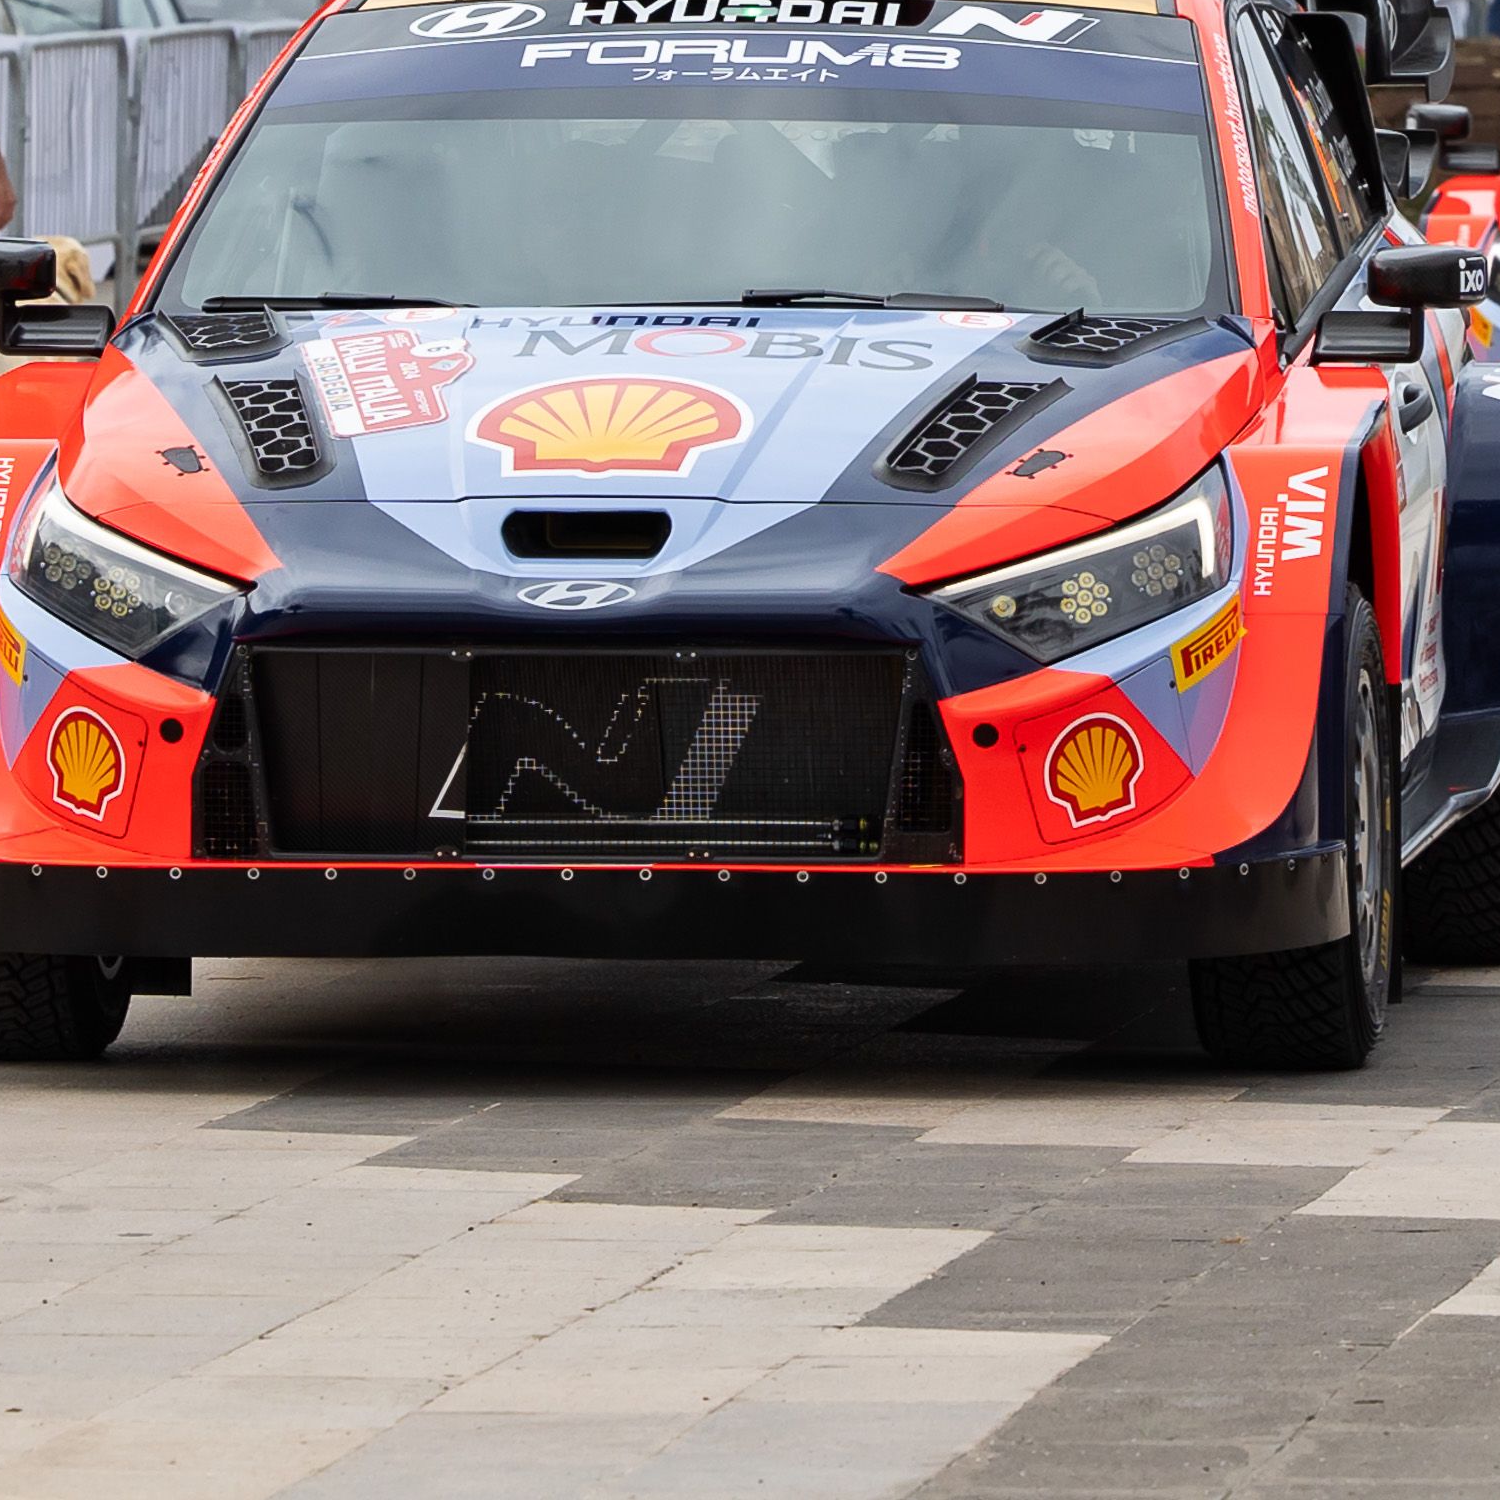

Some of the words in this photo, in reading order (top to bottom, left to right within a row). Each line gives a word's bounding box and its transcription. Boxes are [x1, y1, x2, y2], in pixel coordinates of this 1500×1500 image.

[520, 38, 962, 70] FORUM8
[631, 66, 840, 83] フォーラムエイト
[471, 315, 762, 328] HYUNDAI
[336, 335, 388, 375] RALLY
[512, 327, 936, 371] MOBIS
[313, 356, 354, 412] SARDEGNA
[351, 374, 413, 426] ITALIA
[1253, 506, 1280, 597] HYUNDAI
[1180, 602, 1239, 679] PIRELLI
